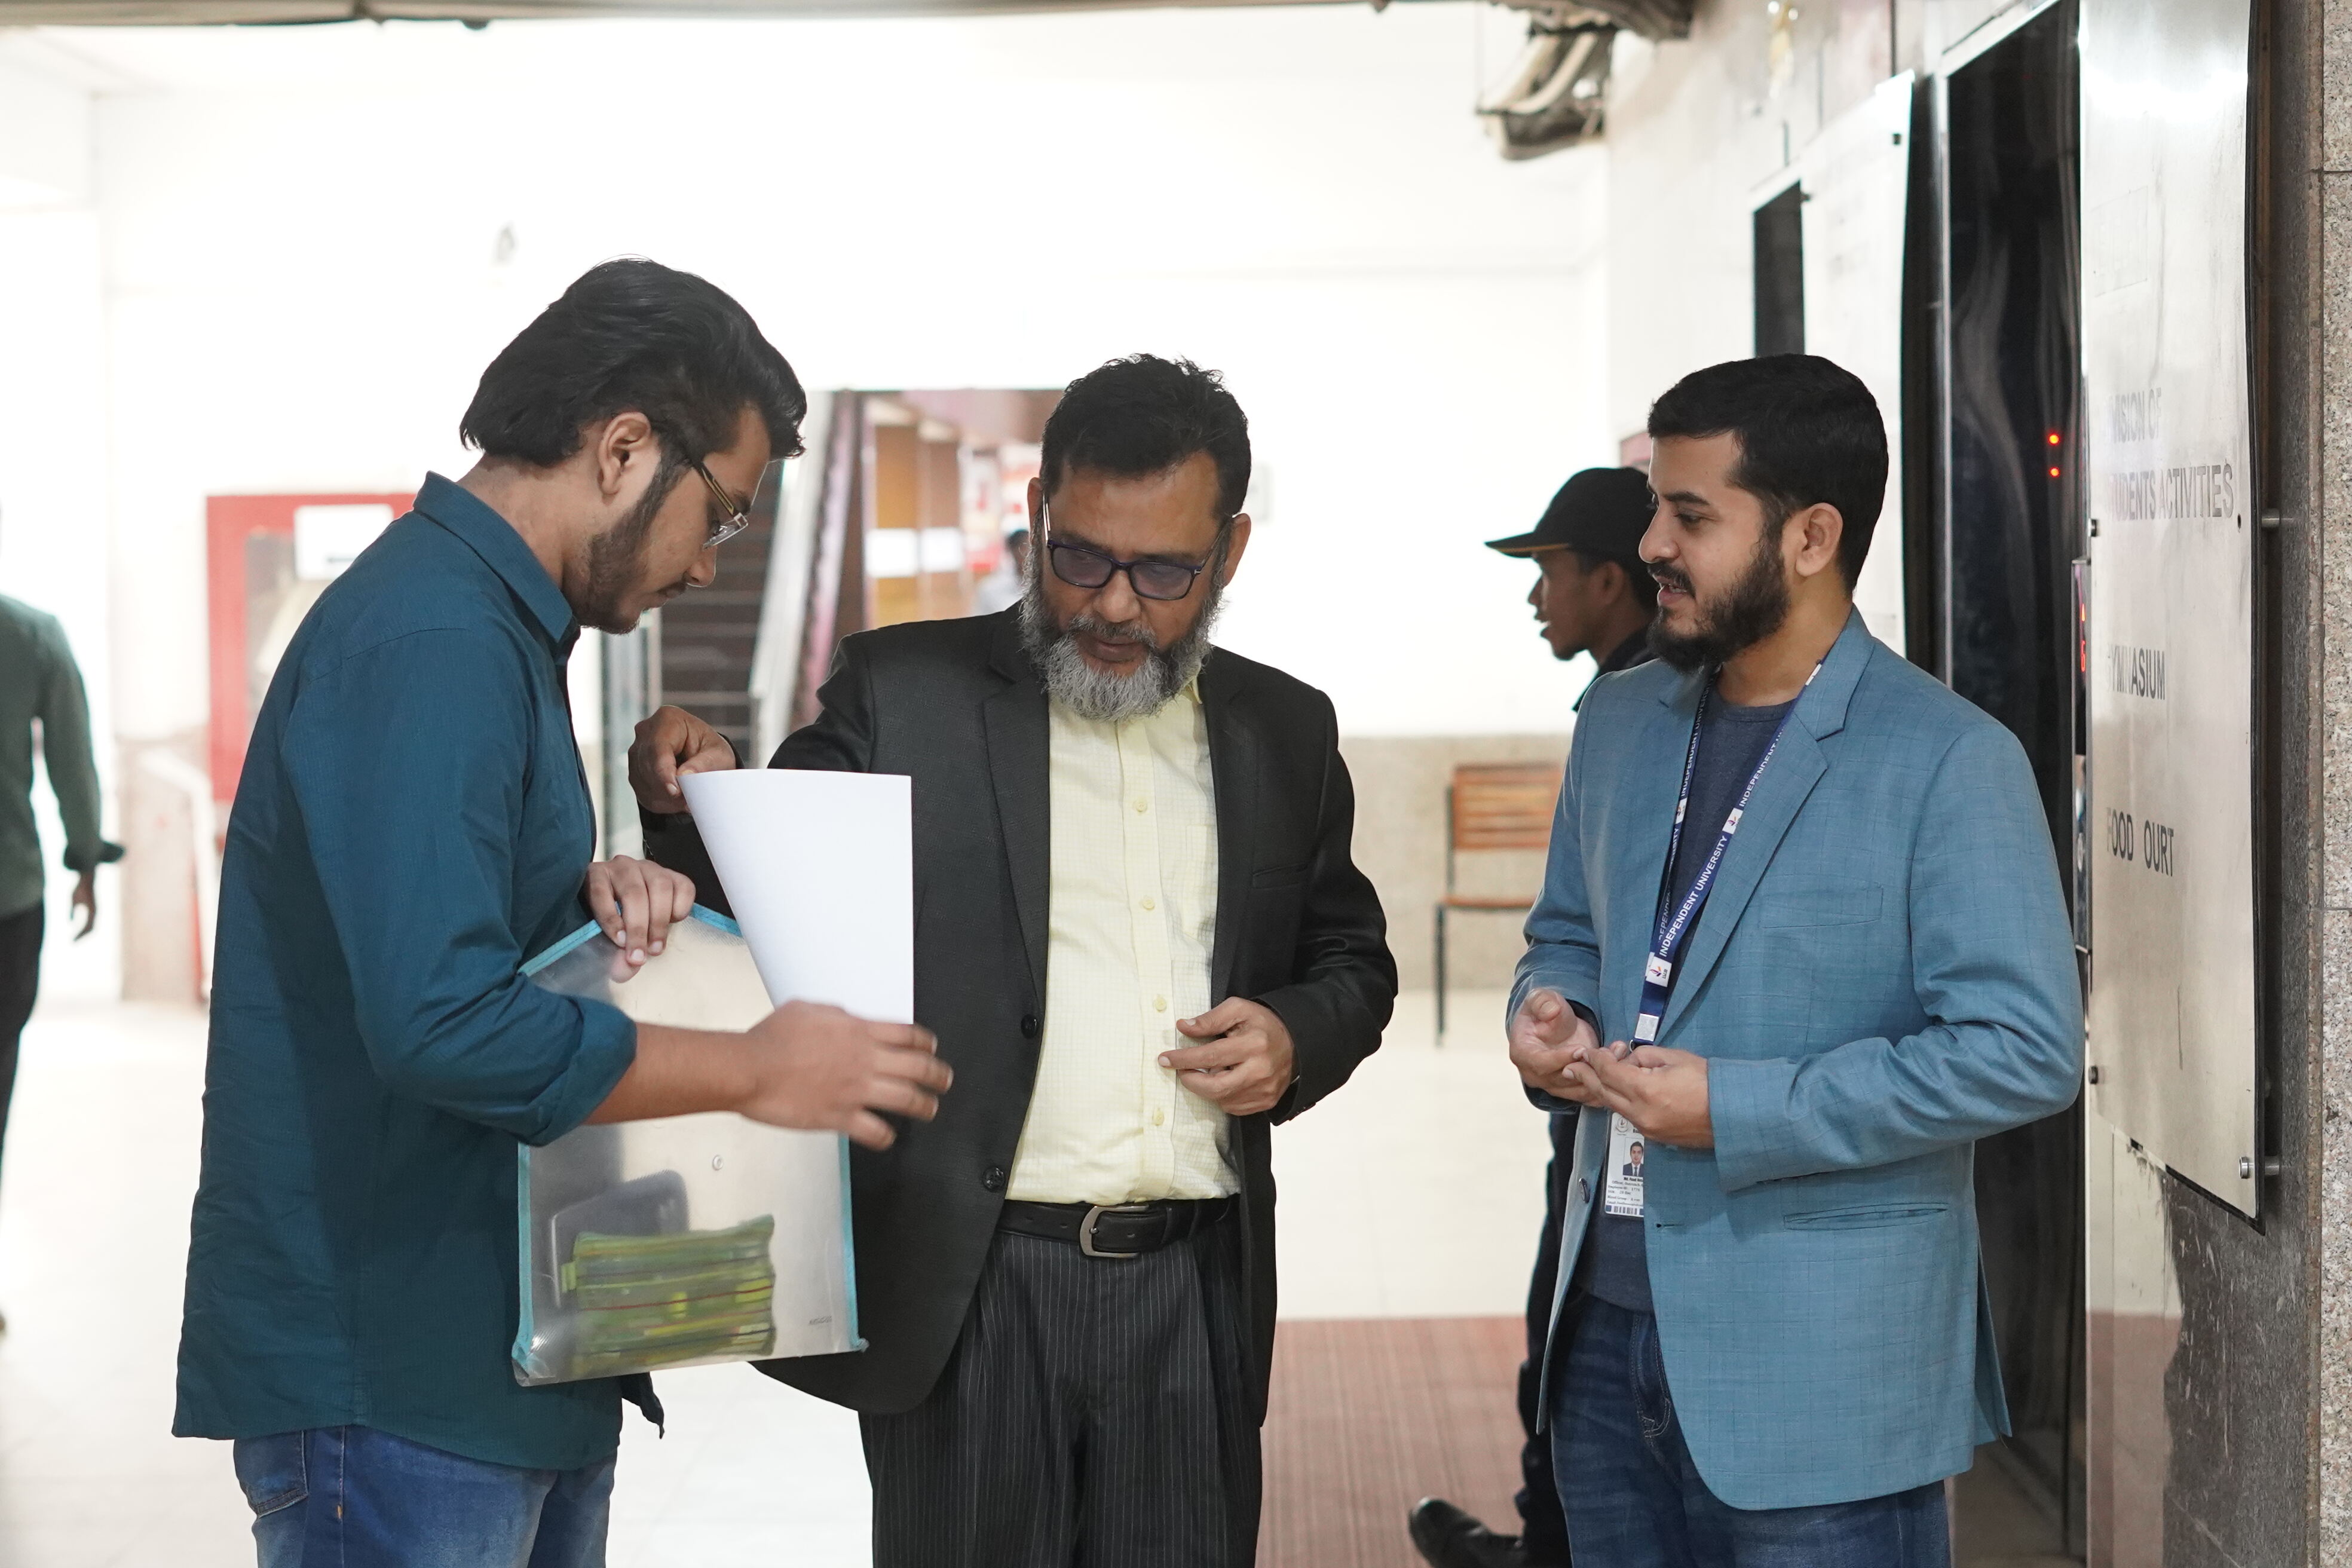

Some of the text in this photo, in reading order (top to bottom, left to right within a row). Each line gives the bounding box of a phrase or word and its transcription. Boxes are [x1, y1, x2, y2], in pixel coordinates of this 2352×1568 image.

[2159, 463, 2234, 519] ACTIVITIES
[2106, 807, 2133, 861] FOOD
[1659, 835, 1728, 957] INDEPENDENT UNIVERSITY
